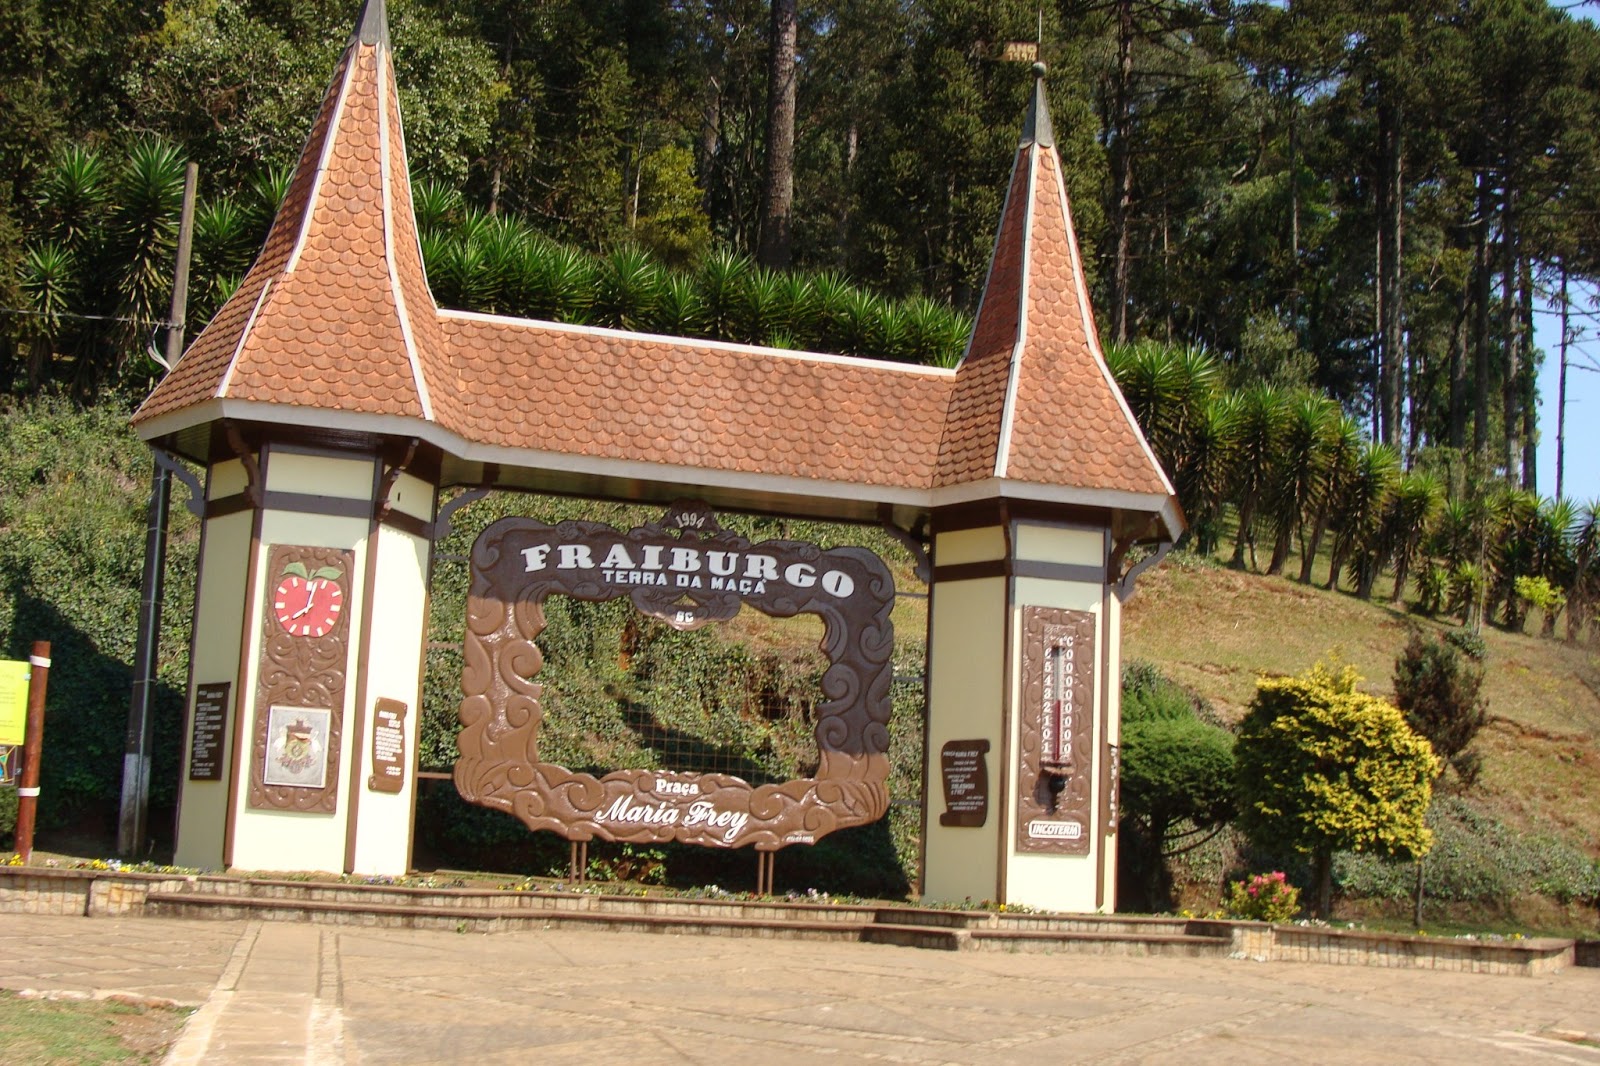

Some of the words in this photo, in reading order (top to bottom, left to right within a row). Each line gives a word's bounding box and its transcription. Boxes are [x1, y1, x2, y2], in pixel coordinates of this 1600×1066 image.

[675, 512, 705, 528] 1994
[520, 543, 854, 598] FRAIBURGO
[602, 570, 667, 586] TERRA
[676, 574, 702, 588] DA
[656, 779, 698, 795] Praça
[595, 794, 679, 824] Maria
[682, 801, 748, 839] Frey
[1032, 824, 1078, 836] INCOTERM
